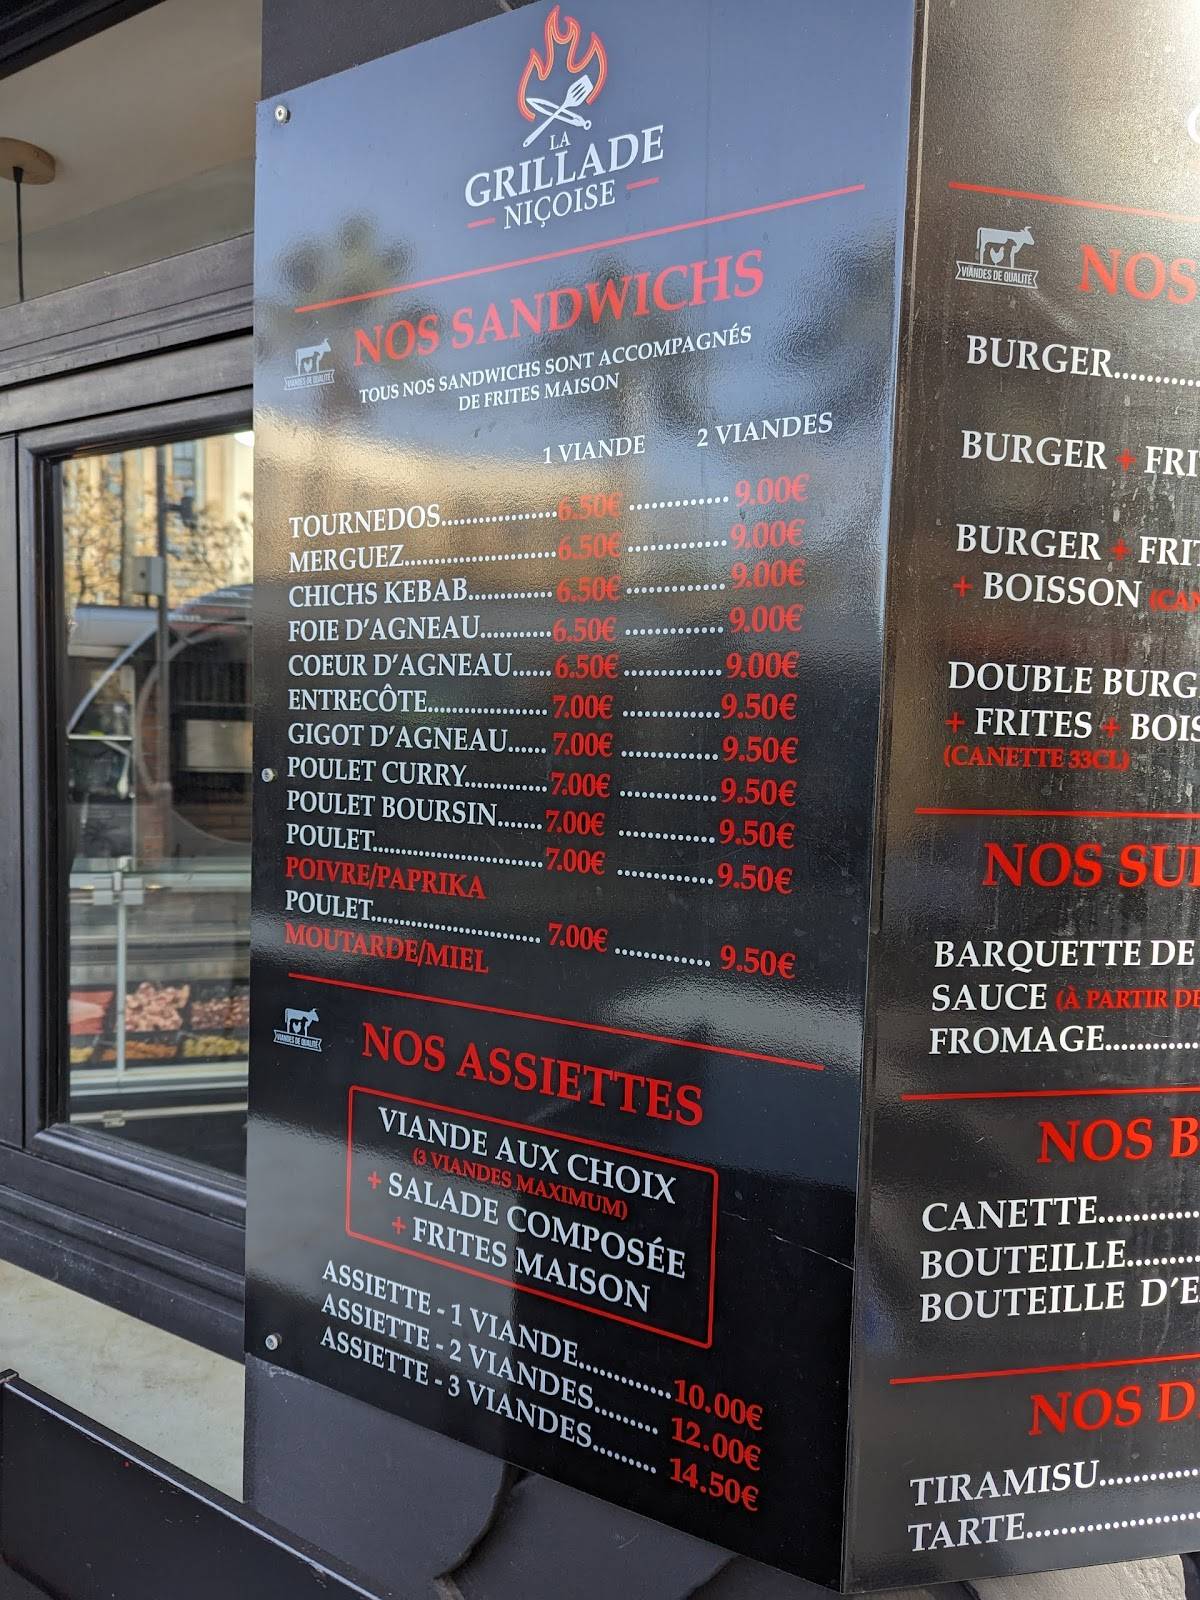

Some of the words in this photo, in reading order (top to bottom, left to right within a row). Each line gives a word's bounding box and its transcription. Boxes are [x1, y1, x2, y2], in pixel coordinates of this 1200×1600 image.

[550, 131, 571, 150] LA
[464, 125, 664, 207] GRILLADE
[504, 179, 615, 228] NIÇOISE
[961, 266, 992, 280] VIANDES
[993, 270, 1003, 281] DE
[1004, 272, 1033, 285] QUALITÉ
[1077, 243, 1197, 305] NOS
[354, 314, 438, 367] NOS
[451, 250, 765, 349] SANDWICHS
[360, 384, 399, 403] TOUS
[403, 378, 435, 397] NOS
[439, 361, 541, 390] SANDWICHS
[545, 353, 594, 374] SONT
[598, 323, 752, 367] ACCOMPAGNÉS
[967, 335, 1113, 378] BURGER
[458, 393, 481, 411] DE
[484, 386, 540, 408] FRITES
[544, 373, 619, 399] MAISON
[543, 446, 551, 464] 1
[559, 435, 645, 462] VIANDE
[697, 428, 707, 447] 2
[715, 411, 833, 444] VIANDES
[961, 429, 1107, 470] BURGER
[1115, 448, 1137, 472] +
[1144, 446, 1200, 477] FRI
[288, 504, 440, 538] TOURNEDOS
[558, 492, 624, 521] 6.50€
[735, 473, 810, 507] 9.00€
[288, 544, 404, 573] MERGUEZ
[557, 532, 622, 560] 6.50€
[730, 519, 806, 549] 9.00€
[956, 523, 1101, 561] BURGER
[1111, 538, 1132, 561] +
[288, 582, 377, 608] CHICHS
[384, 577, 468, 604] KEBAB
[556, 575, 621, 603] 6.50€
[731, 559, 806, 589] 9.00€
[952, 575, 974, 598] +
[983, 571, 1142, 608] BOISSON
[288, 619, 339, 642] FOIE
[345, 615, 480, 641] D'AGNEAU
[553, 616, 616, 643] 6.50€
[729, 604, 804, 634] 9.00€
[288, 654, 368, 676] COEUR
[373, 653, 512, 677] D'AGNEAU
[555, 653, 619, 679] 6.50€
[726, 651, 800, 679] 9.00€
[948, 661, 1092, 695] DOUBLE
[1103, 668, 1200, 699] BURG
[288, 683, 427, 713] ENTRECÔTE
[552, 694, 614, 720] 7.00€
[721, 693, 799, 720] 9.50€
[944, 711, 965, 733] +
[974, 707, 1092, 739] FRITES
[1102, 717, 1121, 739] +
[288, 723, 364, 746] GIGOT
[370, 724, 508, 752] D'AGNEAU
[552, 732, 614, 758] 7.00€
[722, 736, 799, 764] 9.50€
[943, 744, 1063, 769] (CANETTE
[1068, 749, 1131, 770] 33CL)
[287, 756, 376, 782] POULET
[382, 761, 467, 788] CURRY
[551, 772, 611, 797] 7.00€
[720, 777, 797, 807] 9.50€
[287, 790, 375, 817] POULET
[381, 796, 497, 827] BOURSIN
[545, 810, 605, 837] 7.00€
[719, 819, 796, 849] 9.50€
[286, 824, 375, 852] POULET
[546, 848, 606, 876] 7.00€
[717, 862, 793, 895] 9.50€
[286, 856, 488, 900] POIVRE/PAPRIKA
[983, 843, 1104, 888] NOS
[285, 890, 374, 921] POULET
[548, 923, 608, 953] 7.00€
[720, 945, 796, 979] 9.50€
[285, 921, 489, 973] MOUTARDE/MIEL
[934, 940, 1141, 973] BARQUETTE
[1150, 940, 1195, 967] DE
[931, 984, 1047, 1012] SAUCE
[1055, 985, 1080, 1012] (À
[1086, 989, 1168, 1009] PARTIR
[929, 1025, 1104, 1054] FROMAGE
[362, 1022, 446, 1072] NOS
[455, 1043, 704, 1127] ASSIETTES
[378, 1106, 488, 1157] VIANDE
[495, 1136, 560, 1175] AUX
[567, 1153, 677, 1205] CHOIX
[1036, 1118, 1153, 1164] NOS
[412, 1147, 427, 1166] (3
[430, 1151, 512, 1189] VIANDES
[516, 1173, 628, 1220] MAXIMUM)
[367, 1170, 382, 1190] +
[388, 1173, 499, 1226] SALADE
[506, 1205, 686, 1280] COMPOSÉE
[922, 1195, 1098, 1233] CANETTE
[391, 1217, 407, 1236] +
[412, 1216, 508, 1268] FRITES
[515, 1247, 651, 1313] MAISON
[920, 1239, 1126, 1280] BOUTEILLE
[919, 1281, 1125, 1323] BOUTEILLE
[1141, 1276, 1200, 1308] D'E
[322, 1260, 431, 1315] ASSIETTE
[452, 1304, 462, 1327] 1
[470, 1308, 580, 1368] VIANDE
[674, 1379, 764, 1431] 10.00€
[321, 1292, 430, 1350] ASSIETTE
[449, 1340, 462, 1363] 2
[468, 1345, 594, 1411] VIANDES
[671, 1417, 761, 1471] 12.00€
[320, 1327, 429, 1387] ASSIETTE
[448, 1375, 460, 1397] 3
[467, 1380, 592, 1448] VIANDES
[669, 1457, 759, 1512] 14.50€
[1029, 1385, 1142, 1436] NOS
[1158, 1380, 1200, 1423] D
[910, 1460, 1099, 1507] TIRAMISU
[908, 1512, 1025, 1553] TARTE
